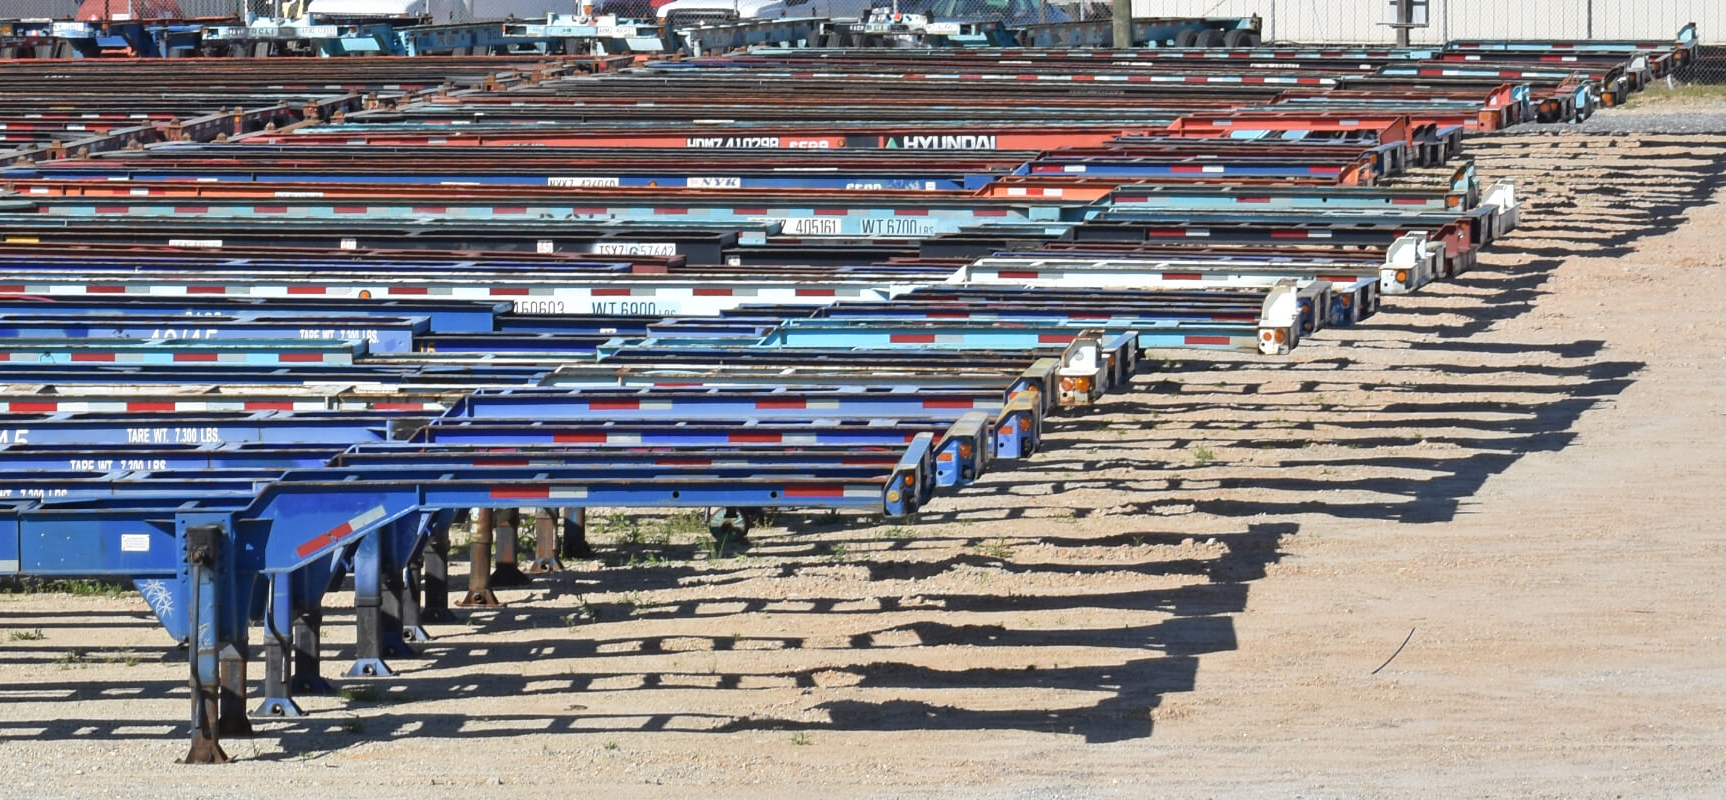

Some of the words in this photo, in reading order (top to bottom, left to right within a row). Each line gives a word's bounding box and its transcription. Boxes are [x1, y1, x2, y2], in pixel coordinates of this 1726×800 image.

[903, 135, 996, 149] HYUNDAI
[862, 219, 883, 234] WT
[127, 428, 150, 443] TARE
[200, 428, 221, 443] LBS.
